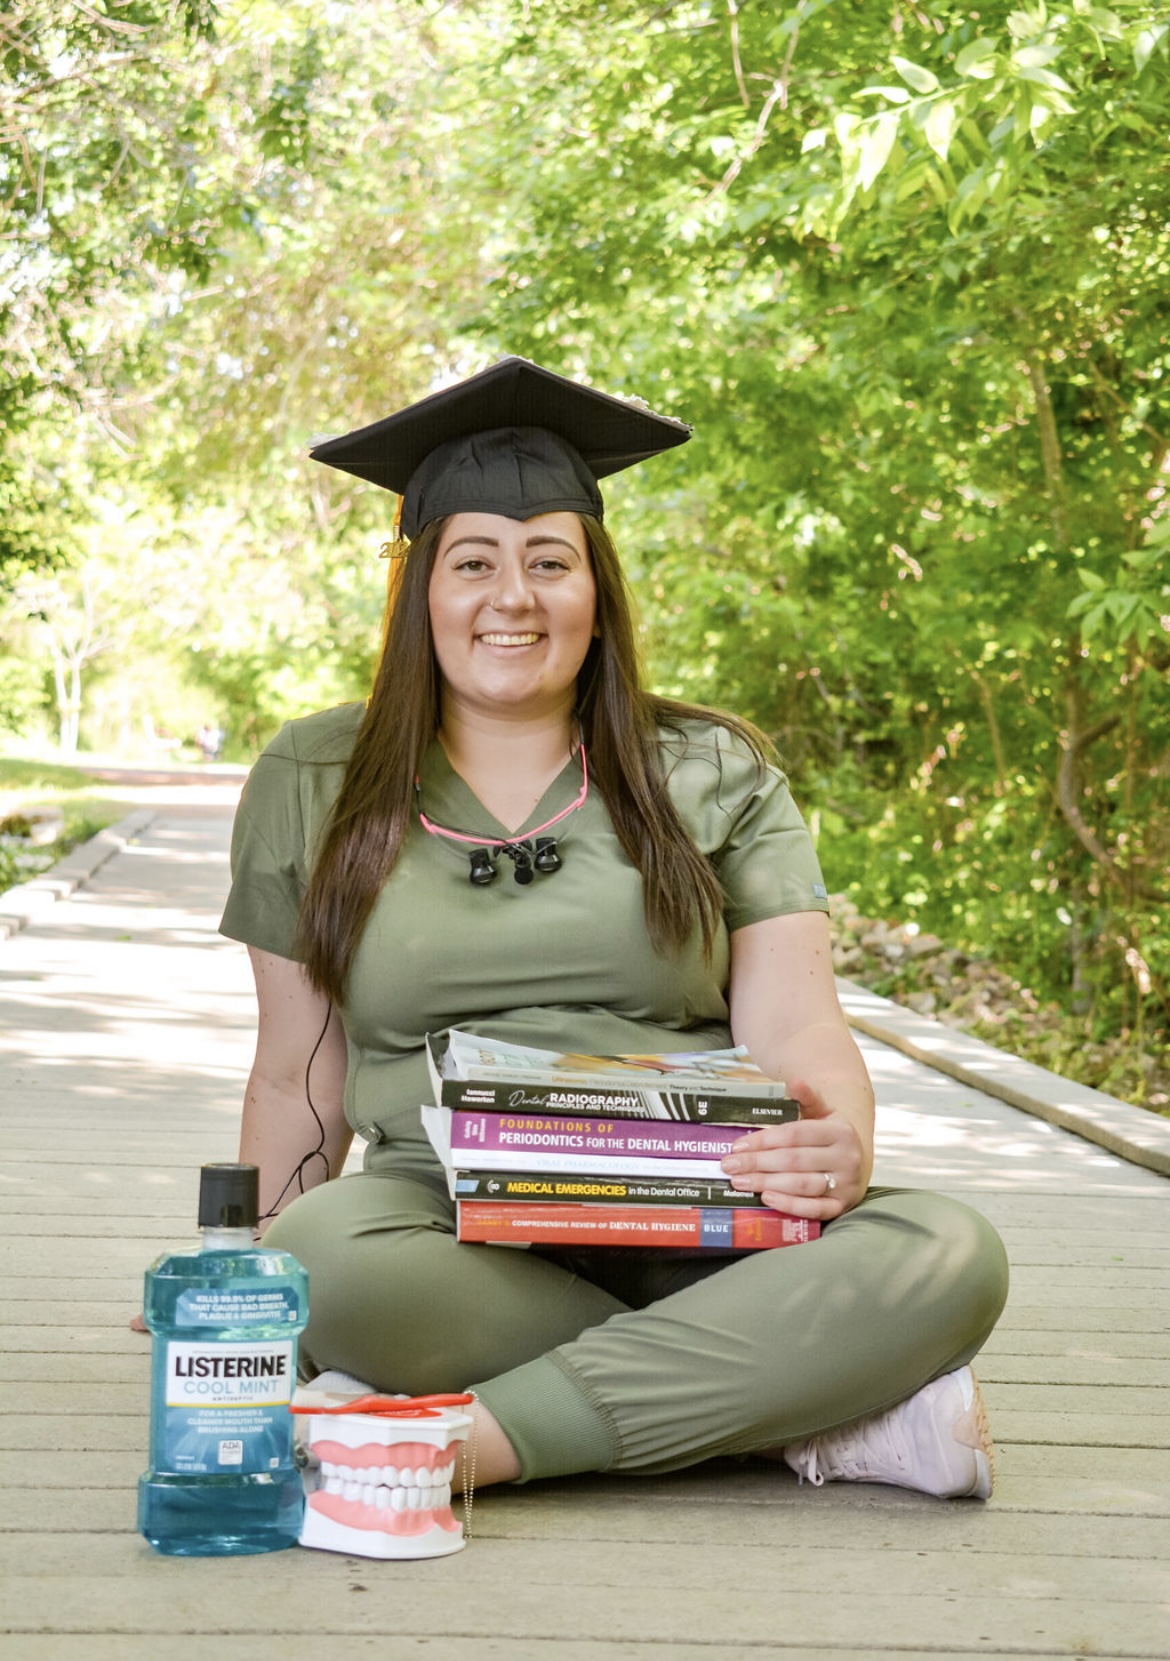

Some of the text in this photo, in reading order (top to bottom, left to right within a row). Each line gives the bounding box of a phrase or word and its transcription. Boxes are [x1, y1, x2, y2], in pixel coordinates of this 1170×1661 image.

[508, 1089, 638, 1108] Dental RADIOGRAPHY
[545, 1102, 585, 1110] PRINCIPLES
[585, 1103, 601, 1111] AND
[752, 1107, 783, 1116] ELSEVIER
[499, 1118, 592, 1133] FOUNDATIONS
[597, 1123, 613, 1133] OF
[499, 1132, 733, 1154] PERIODONTICS FOR THE DENTAL HYGIENIST
[507, 1181, 700, 1197] MEDICAL EMERGENCIES in the Dental Office
[512, 1220, 569, 1229] COMPREHENSIVE
[570, 1221, 597, 1229] REVIEW
[609, 1221, 649, 1231] DENTAL
[651, 1222, 696, 1232] HYGIENE
[704, 1224, 729, 1233] BLUE
[195, 1294, 220, 1303] KILLS
[245, 1294, 256, 1302] OF
[257, 1293, 284, 1302] GERMS
[188, 1303, 211, 1312] THAT
[212, 1303, 240, 1312] CAUSE
[241, 1302, 259, 1311] BAD
[198, 1312, 232, 1321] PLAQUE
[175, 1354, 287, 1378] LISTERINE
[183, 1379, 280, 1395] COOL MINT
[199, 1409, 215, 1417] FOR
[187, 1417, 223, 1425] CLEANER
[224, 1417, 253, 1425] MOUTH
[239, 1425, 264, 1433] ALONE
[222, 1441, 240, 1449] ADA
